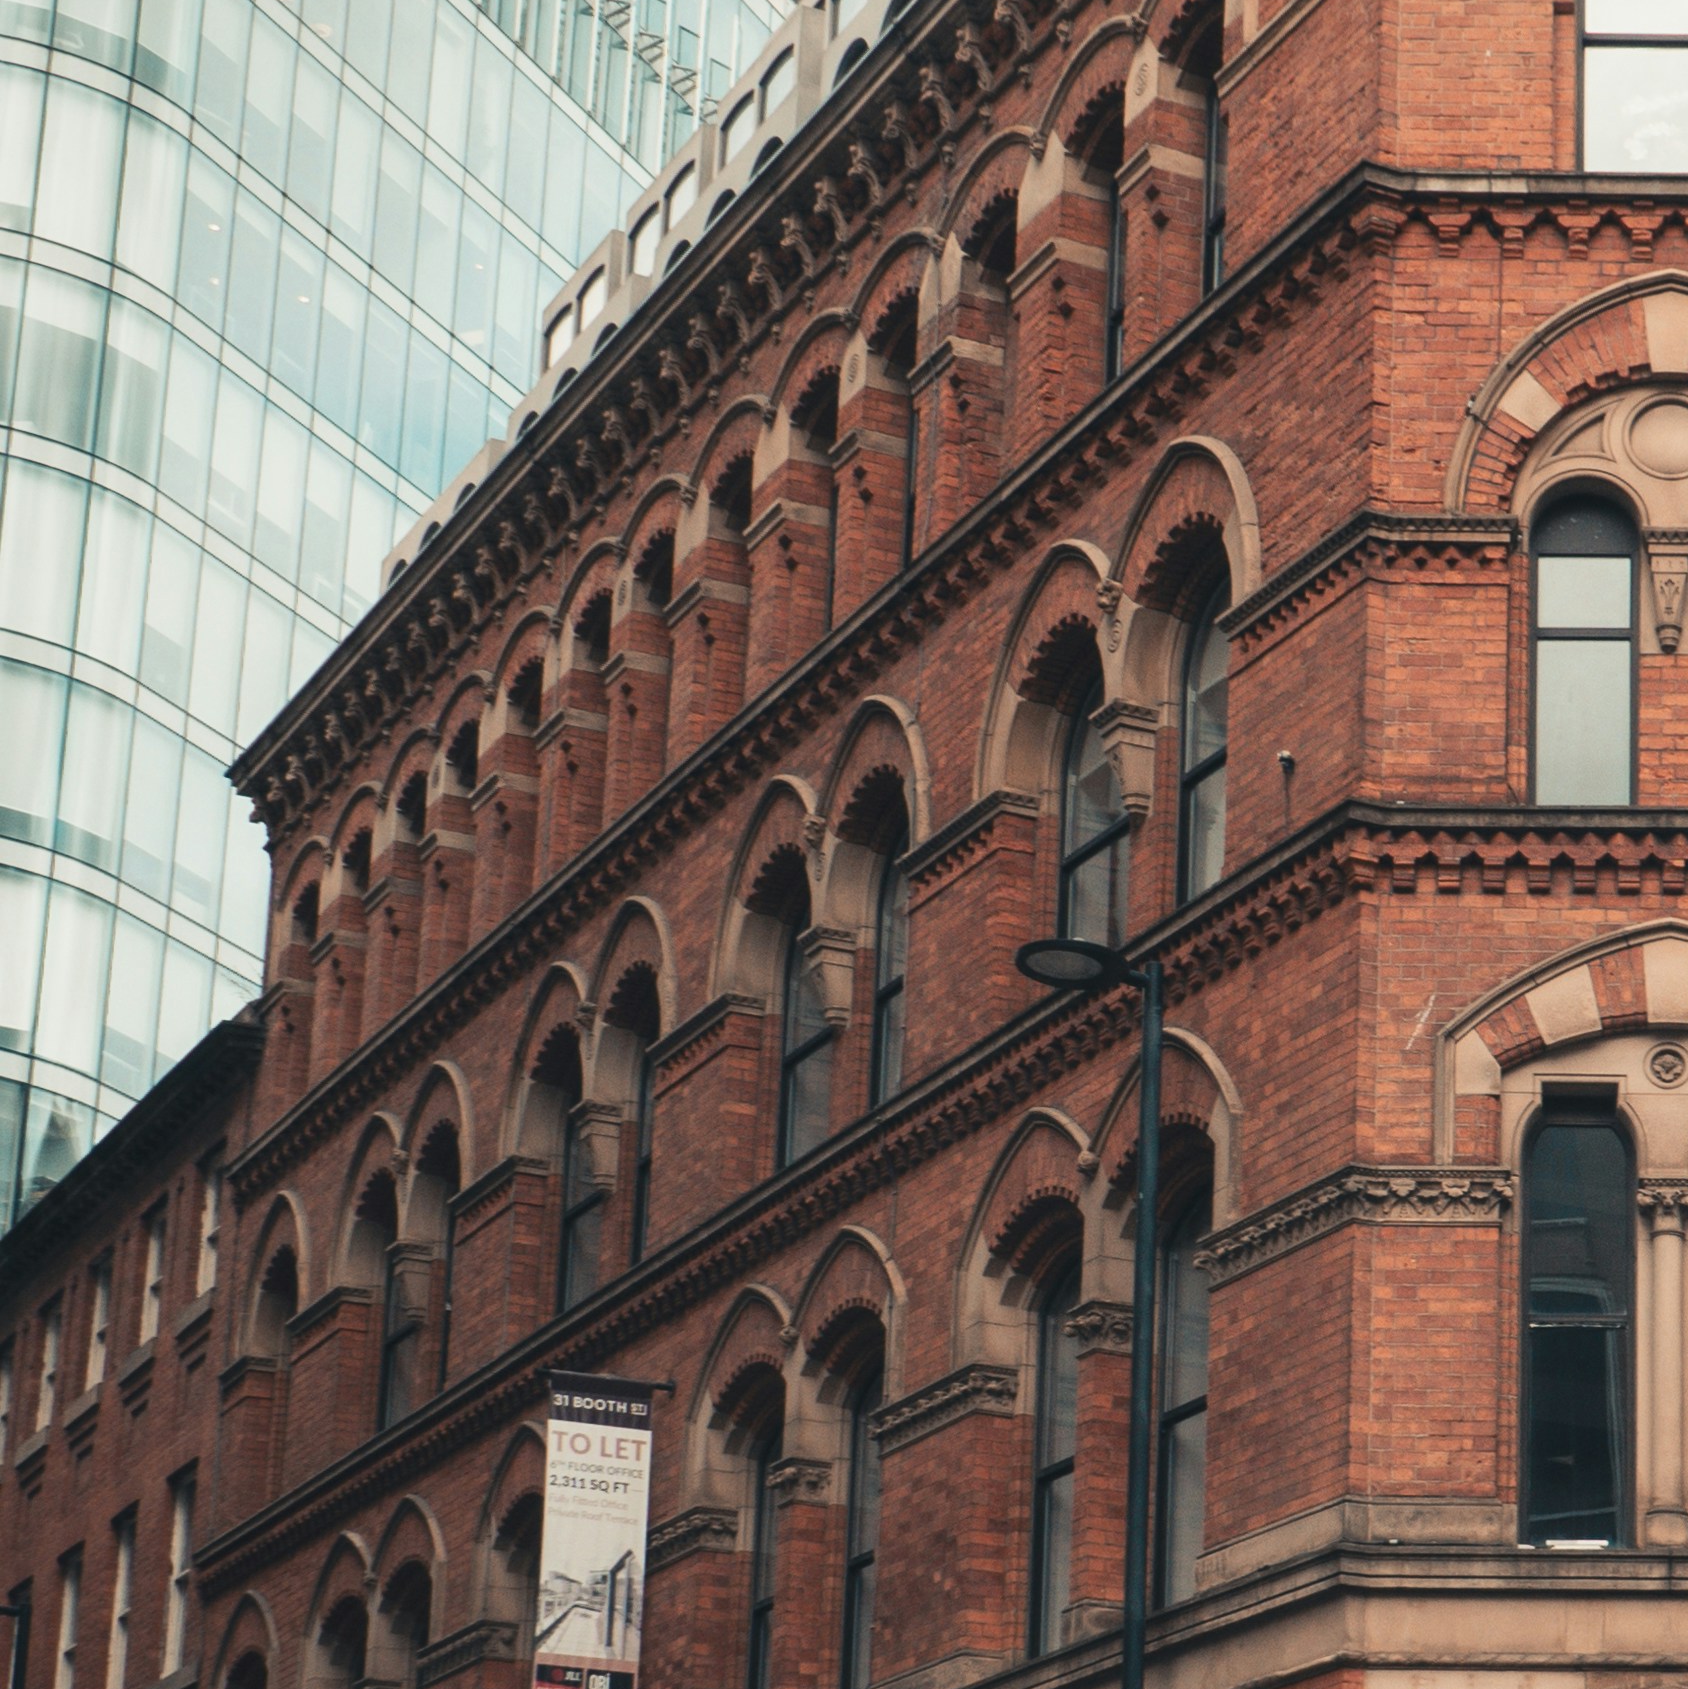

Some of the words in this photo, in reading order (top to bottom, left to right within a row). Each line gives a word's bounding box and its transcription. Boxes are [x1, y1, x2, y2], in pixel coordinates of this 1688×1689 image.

[553, 1394, 569, 1406] 31
[573, 1397, 627, 1413] BOOTH
[553, 1431, 591, 1454] TO
[601, 1435, 647, 1461] LET
[568, 1461, 604, 1473] FLOOR
[607, 1465, 643, 1479] OFFICE
[550, 1475, 586, 1490] 2,311
[590, 1479, 609, 1493] SQ
[613, 1482, 629, 1493] FT
